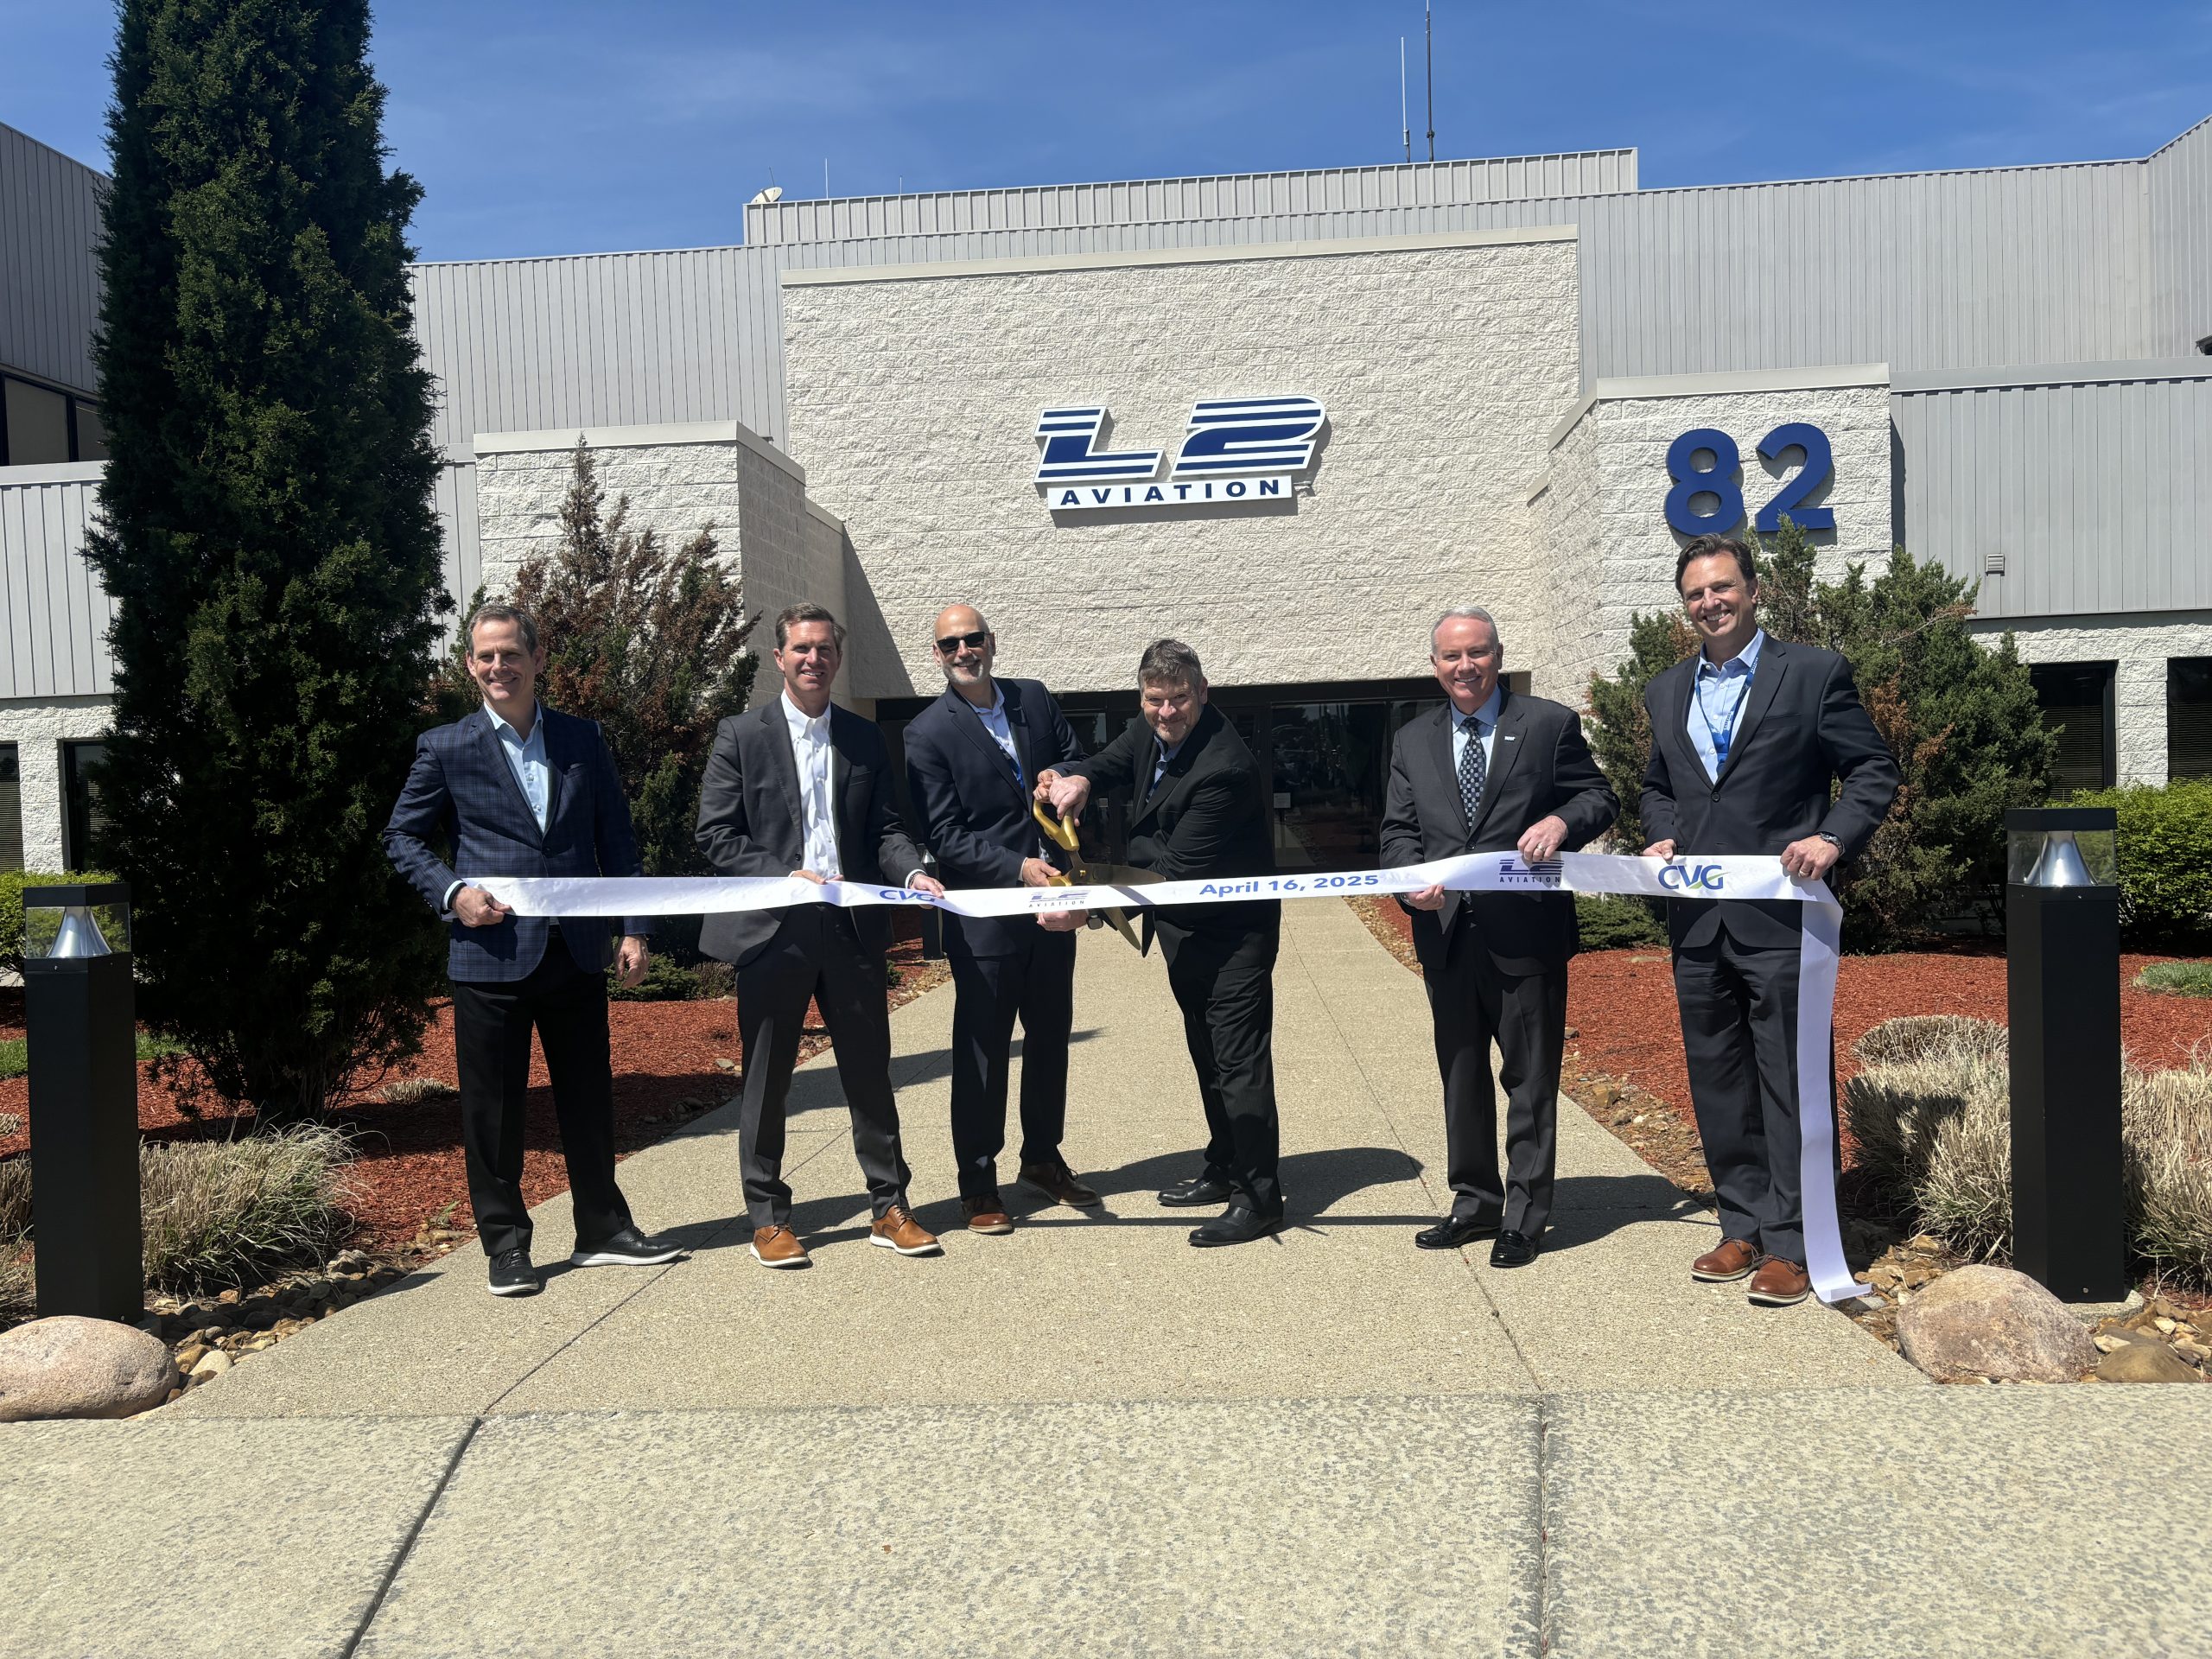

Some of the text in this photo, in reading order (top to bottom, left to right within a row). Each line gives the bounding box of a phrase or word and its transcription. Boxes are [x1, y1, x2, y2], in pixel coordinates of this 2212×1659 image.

[1033, 394, 1325, 482] L2
[1060, 479, 1279, 505] AVIATION
[1666, 423, 1834, 536] 82
[1199, 874, 1379, 898] April 16, 2025
[1657, 864, 1725, 890] CVG
[879, 889, 936, 902] CVG
